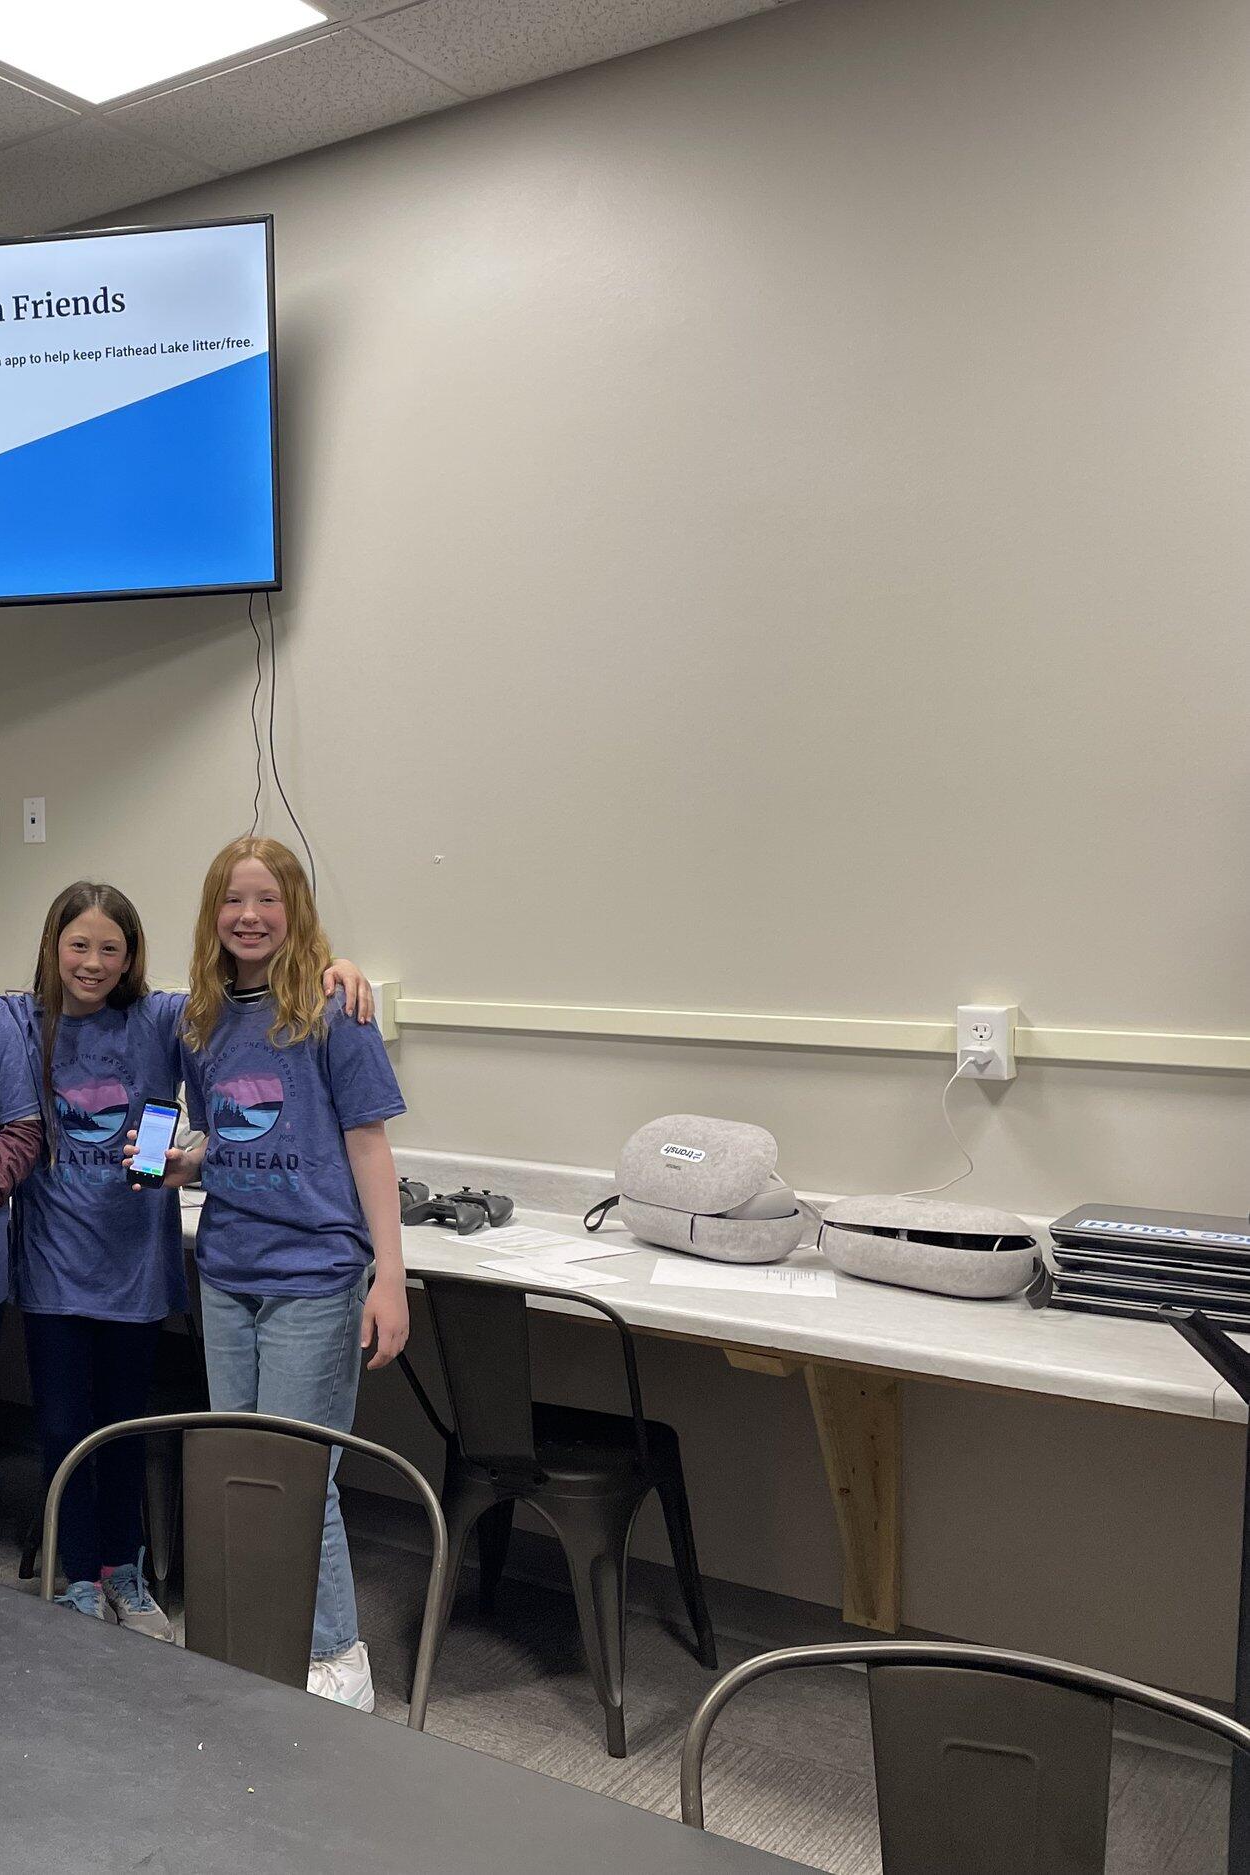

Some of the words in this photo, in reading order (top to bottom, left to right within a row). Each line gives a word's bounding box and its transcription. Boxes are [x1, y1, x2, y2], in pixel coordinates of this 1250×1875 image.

[12, 286, 126, 321] Friends
[4, 356, 27, 368] app
[29, 354, 42, 364] to
[44, 351, 70, 365] help
[72, 349, 102, 362] keep
[105, 343, 157, 358] Flathead
[160, 341, 189, 354] Lake
[192, 336, 254, 352] litter/free.
[1088, 1221, 1189, 1237] YOUTH
